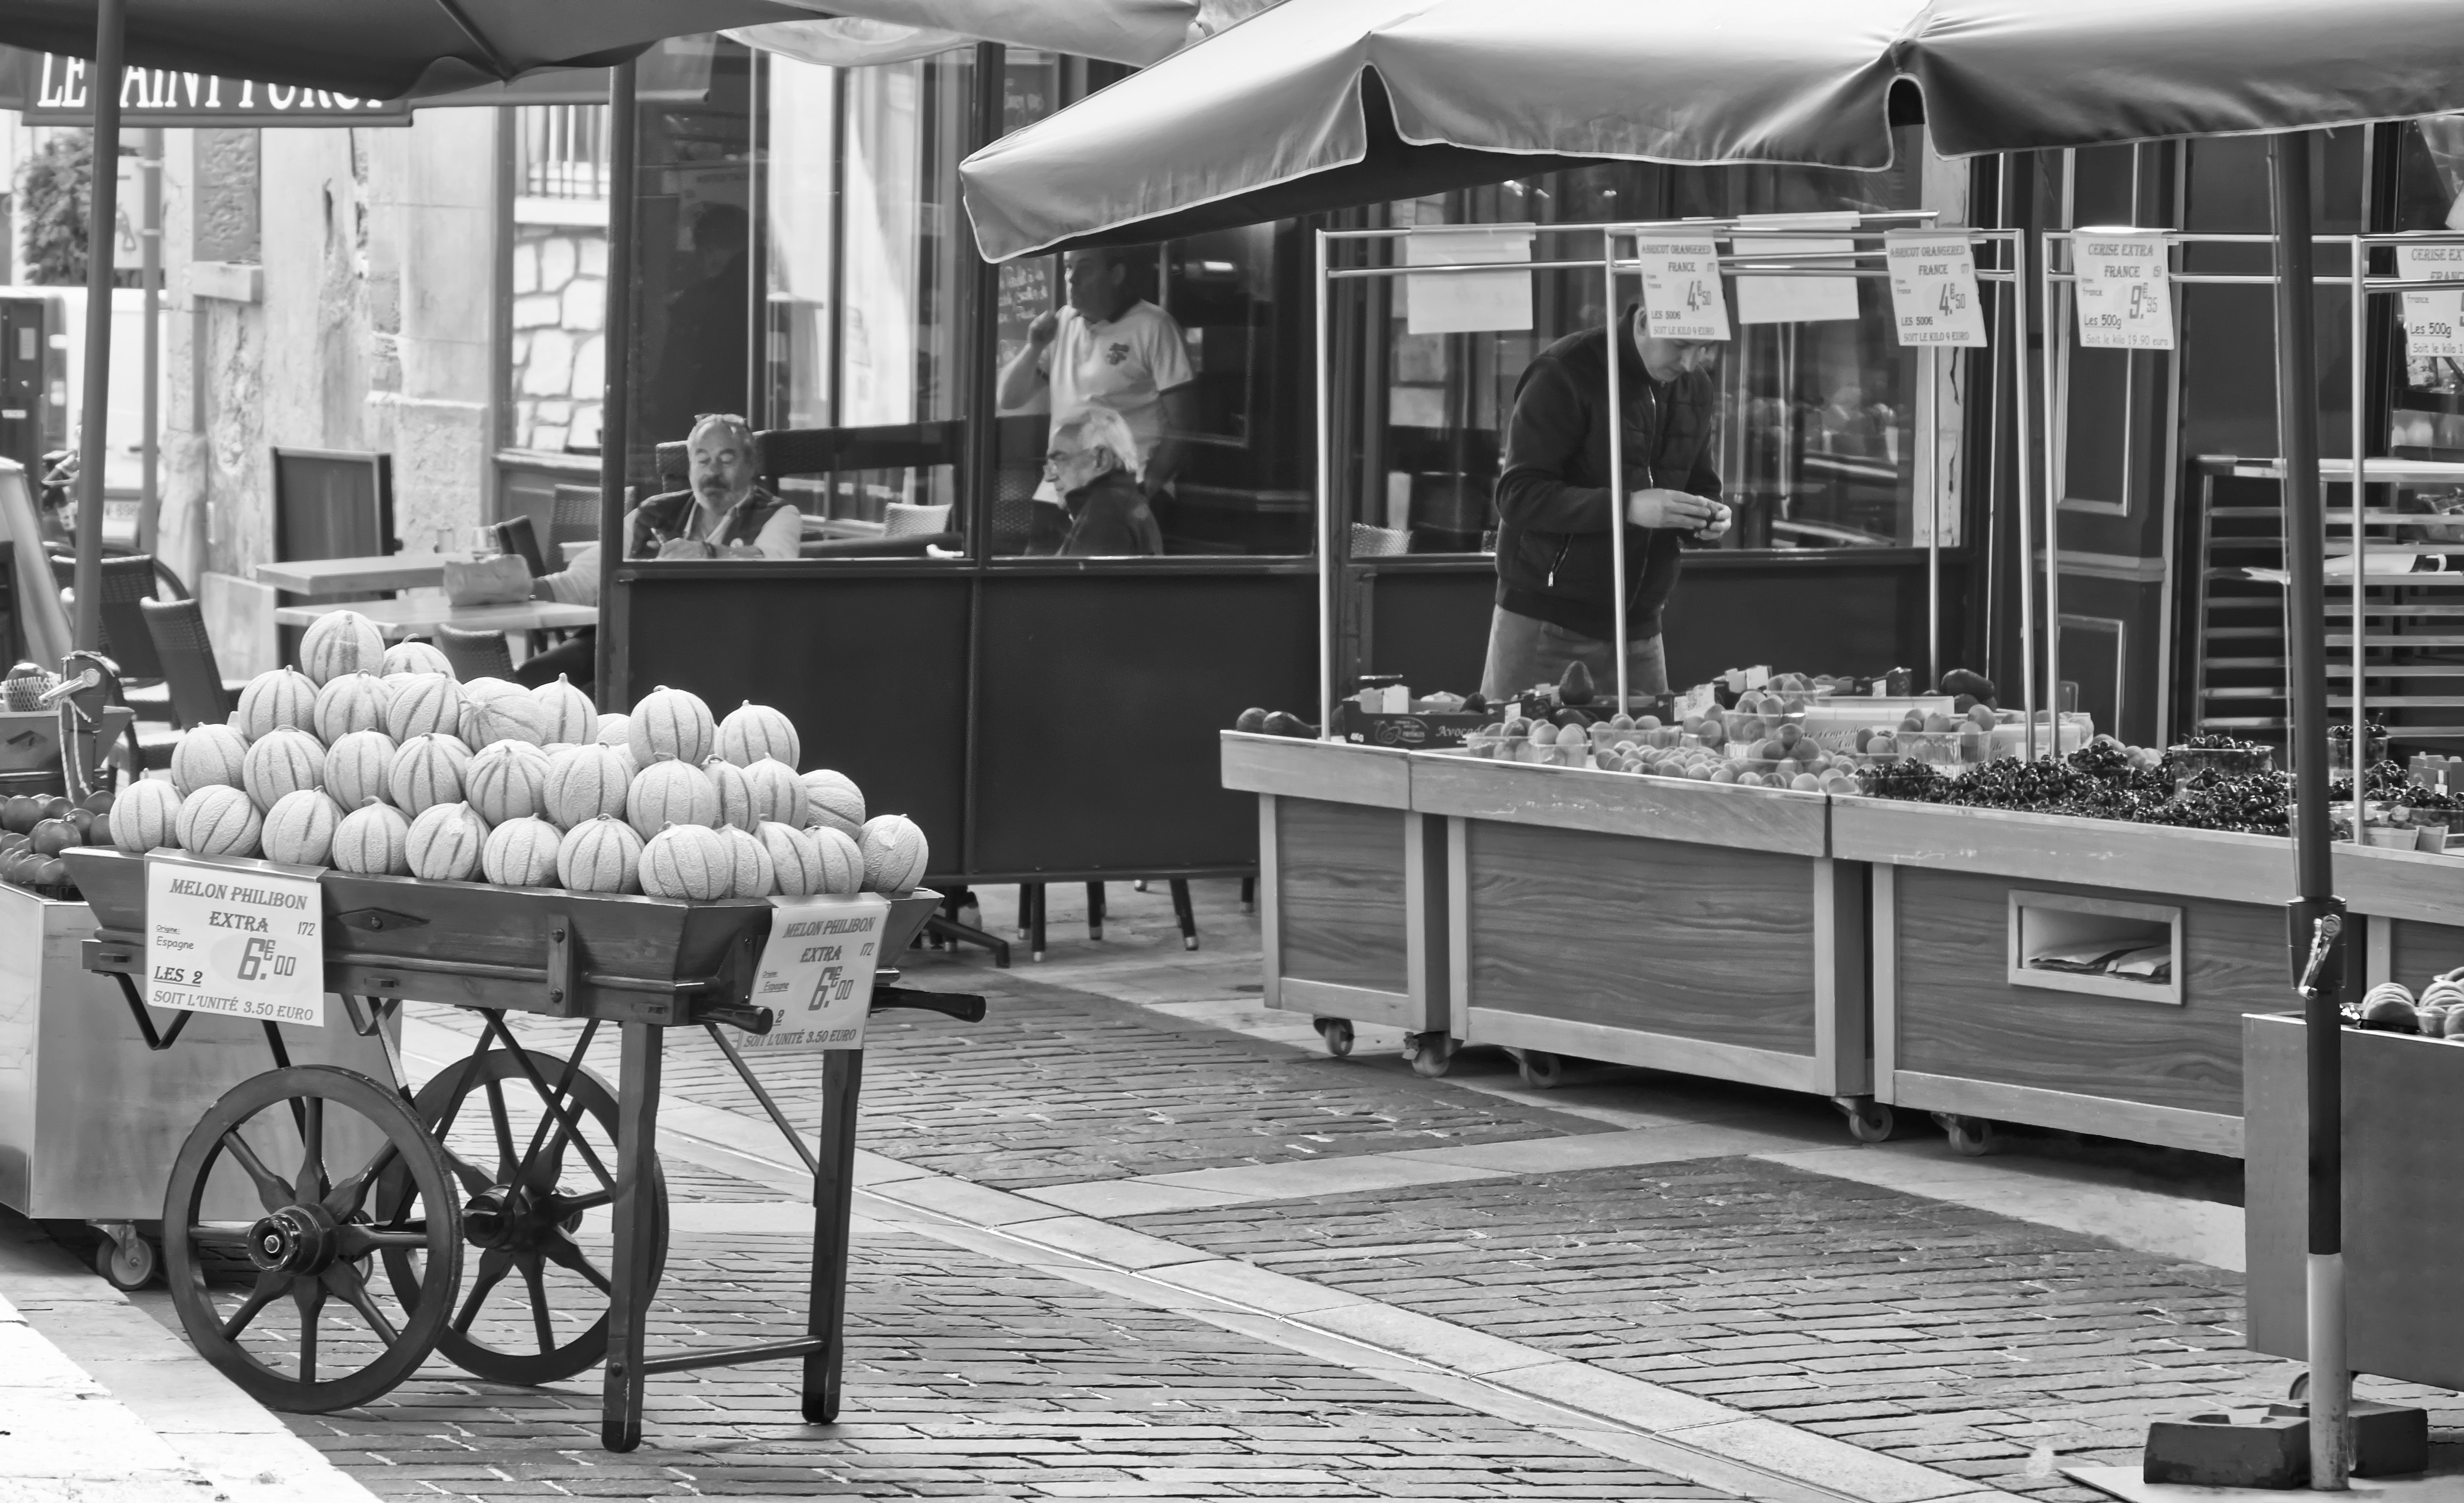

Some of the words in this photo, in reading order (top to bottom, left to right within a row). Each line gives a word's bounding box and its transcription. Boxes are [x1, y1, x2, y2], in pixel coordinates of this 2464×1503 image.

[37, 51, 87, 108] LE
[1889, 247, 1920, 258] ABRICOT
[1921, 245, 1966, 256] ORANGERED
[2088, 243, 2119, 256] CERISE
[2121, 244, 2154, 256] EXTRA
[2411, 249, 2446, 261] CERISE
[1668, 262, 1696, 272] FRANCE
[1918, 265, 1948, 275] FRANCE
[2104, 266, 2141, 278] FRANCE
[1651, 310, 1663, 319] LES
[1901, 317, 1913, 326] LES
[2084, 314, 2098, 326] Les
[2101, 314, 2122, 330] 500g
[1668, 326, 1676, 335] LE
[1677, 326, 1692, 335] KILO
[1698, 326, 1715, 335] EURO
[1904, 333, 1919, 342] SOIT
[1919, 333, 1928, 342] LE
[1929, 332, 1944, 341] KILO
[1945, 332, 1950, 341] 9
[1952, 332, 1970, 341] EURO
[2410, 322, 2425, 334] Les
[2429, 322, 2451, 338] 500g
[2086, 334, 2100, 344] Soit
[2104, 334, 2110, 344] le
[169, 879, 228, 901] MELON
[230, 886, 308, 911] PHILIBON
[209, 911, 268, 933] EXTRA
[298, 921, 316, 936] 172
[782, 920, 825, 938] MELON
[822, 917, 876, 935] PHILIBON
[156, 925, 180, 934] Origine:
[157, 936, 194, 951] Espagne
[800, 945, 842, 963] EXTRA
[153, 966, 184, 982] LES
[192, 971, 203, 985] 2
[153, 990, 185, 1005] SOIT
[187, 995, 239, 1012] L'UNITÉ
[243, 1001, 273, 1016] 3.50
[277, 1005, 314, 1021] EURO
[775, 1009, 785, 1023] 2
[744, 1034, 770, 1048] SOIT
[766, 1029, 805, 1046] L'UNITÉ
[806, 1031, 827, 1044] 3.50
[829, 1029, 856, 1041] EURO
